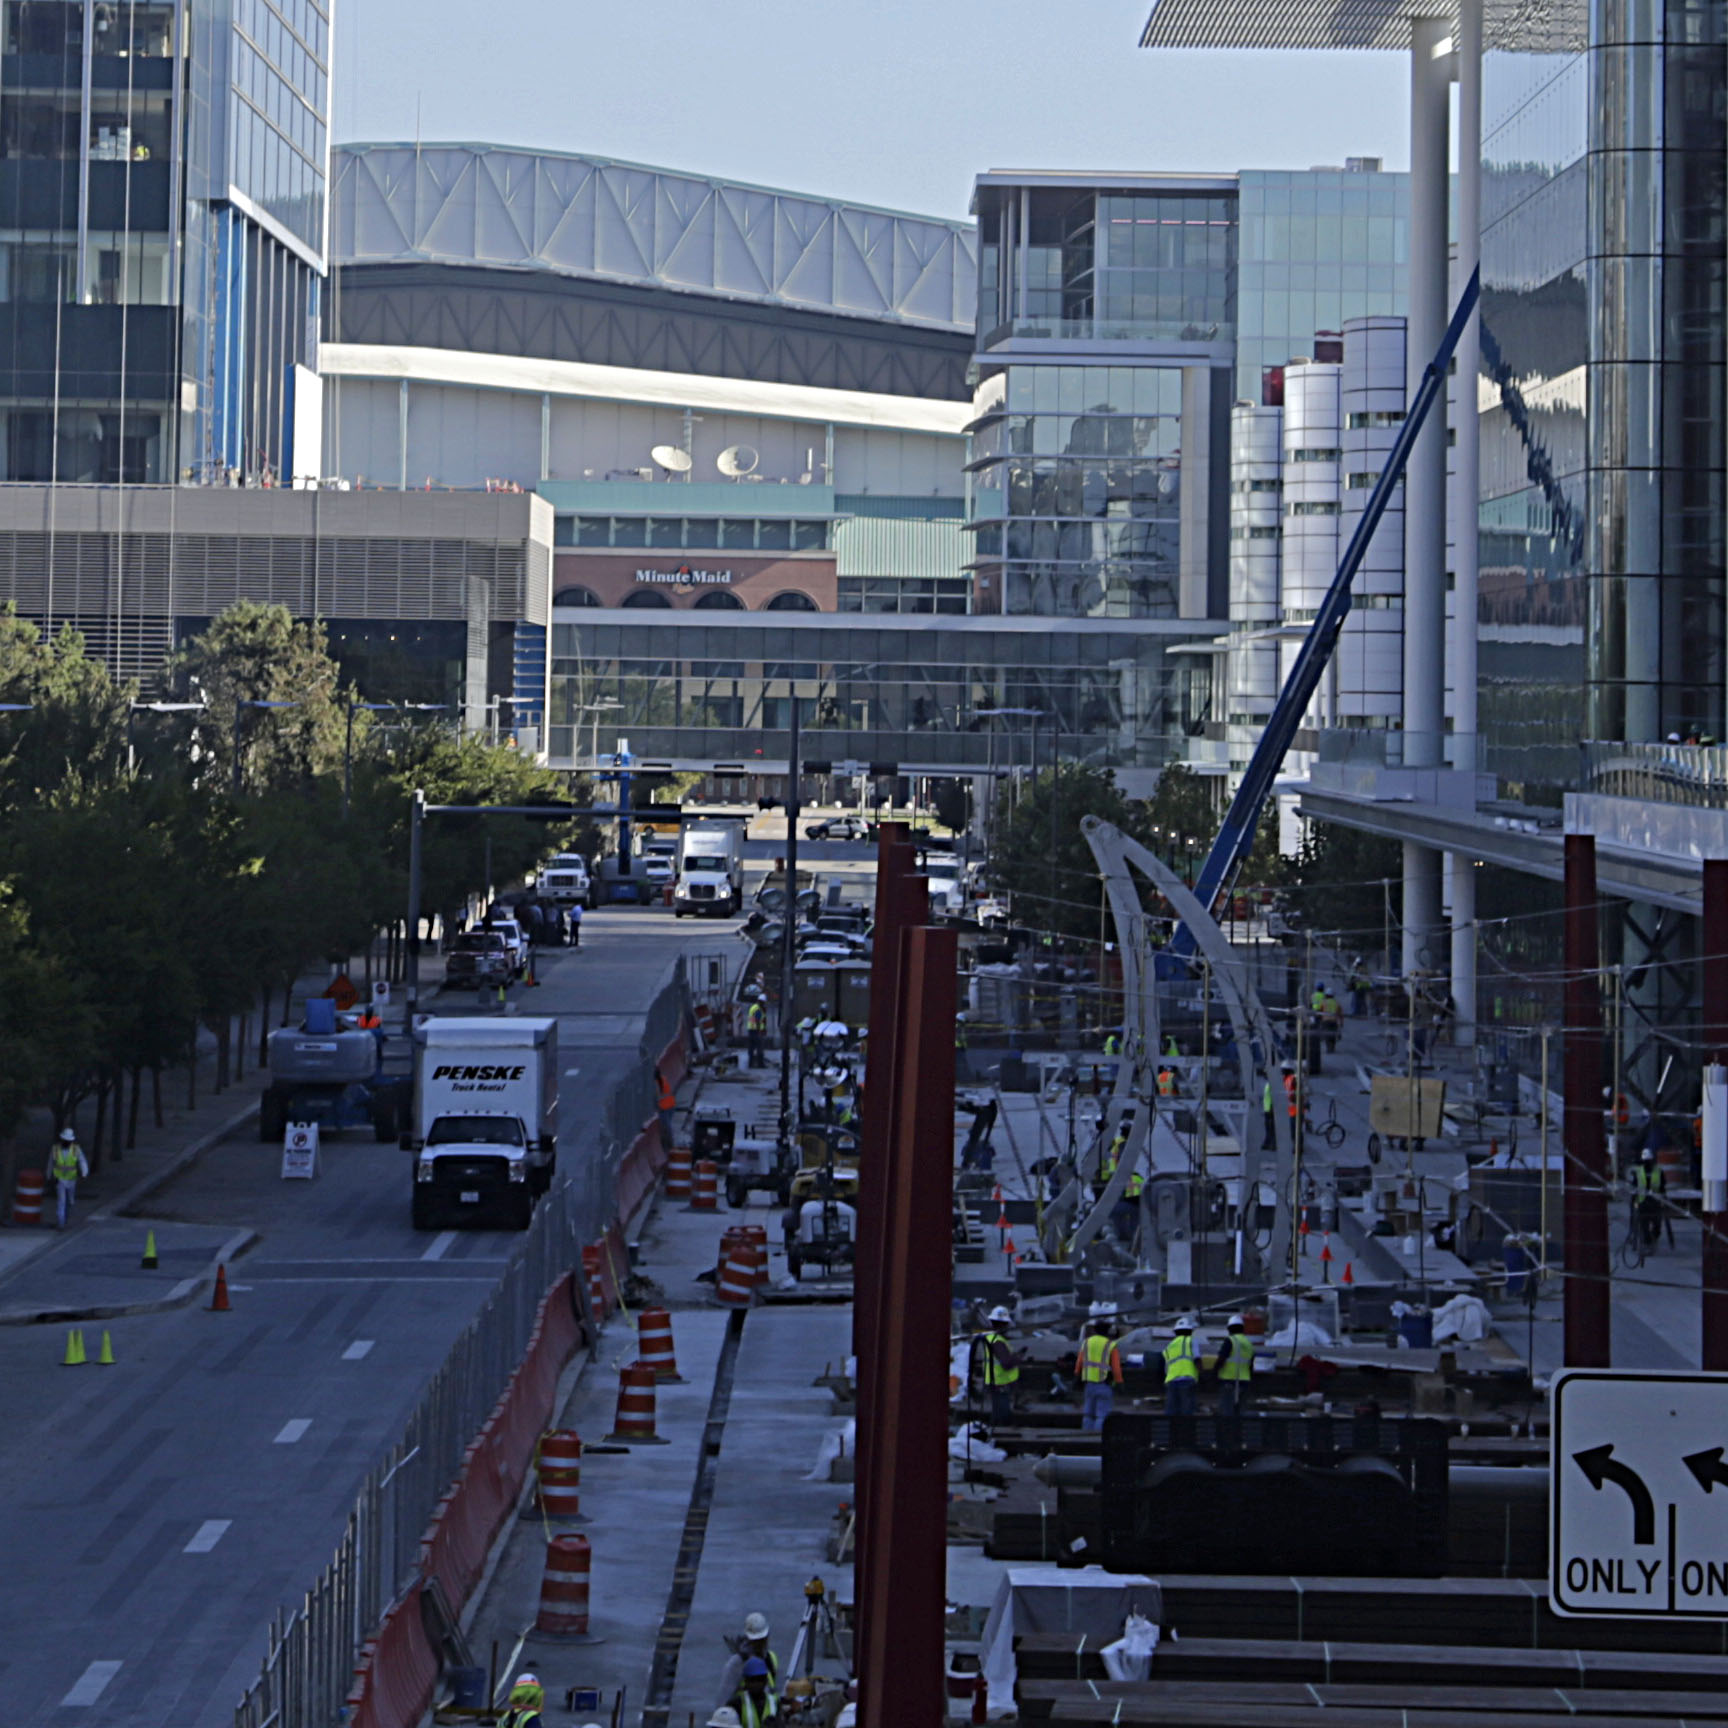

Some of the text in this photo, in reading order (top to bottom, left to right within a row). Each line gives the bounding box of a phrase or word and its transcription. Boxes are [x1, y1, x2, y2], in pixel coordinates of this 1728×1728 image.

[636, 569, 731, 583] Minute Maid
[432, 1065, 526, 1080] PENSKE
[451, 1082, 506, 1093] Truck Rental
[1566, 1557, 1661, 1594] ONLY
